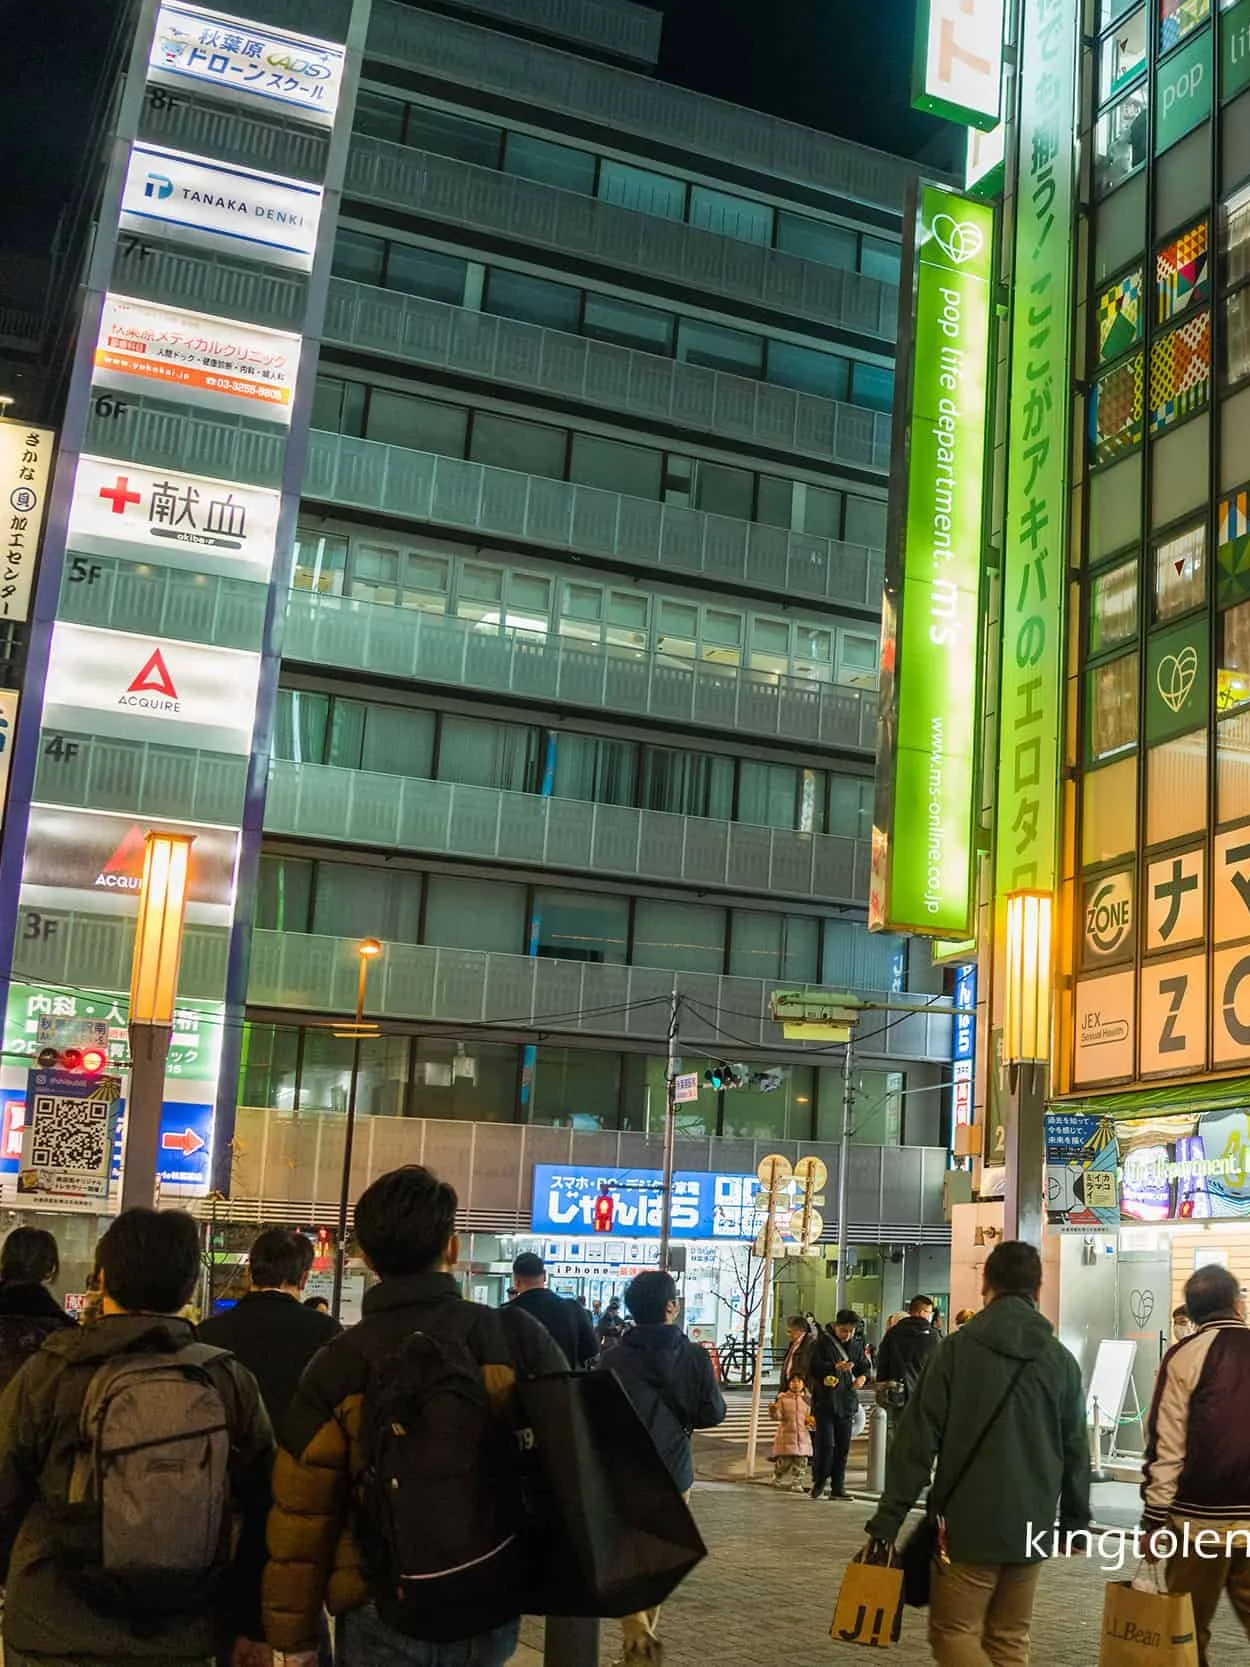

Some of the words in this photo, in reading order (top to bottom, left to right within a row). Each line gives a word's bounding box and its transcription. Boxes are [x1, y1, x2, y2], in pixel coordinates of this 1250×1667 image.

[199, 27, 266, 59] 秋葉原
[187, 47, 327, 100] ドローンスクール
[151, 88, 179, 112] 8F
[1162, 61, 1204, 119] pop
[182, 188, 248, 213] TANAKA
[255, 207, 304, 226] DENKI
[121, 239, 153, 262] 7F
[937, 287, 961, 340] pop
[938, 346, 963, 388] life
[95, 394, 128, 419] 6F
[934, 391, 963, 570] department.
[149, 481, 247, 538] 献血
[68, 557, 102, 585] 5F
[929, 583, 959, 647] m's
[118, 695, 181, 712] ACQUIRE
[45, 735, 79, 764] 4F
[927, 717, 943, 914] www.ms-online.co.jp
[95, 873, 144, 889] ACQUI
[22, 912, 58, 941] 3F
[1086, 898, 1130, 934] ZONE
[1081, 1012, 1101, 1030] JEX
[557, 1266, 609, 1274] iPhone
